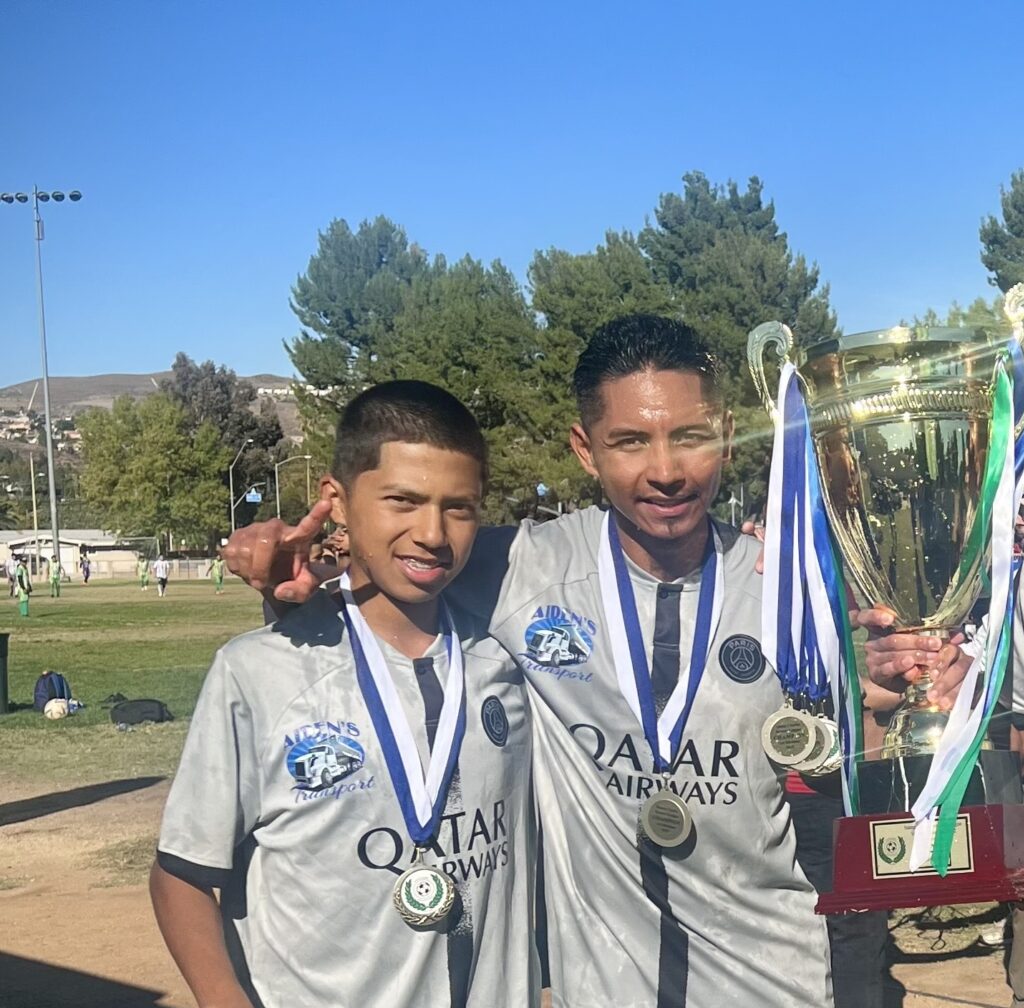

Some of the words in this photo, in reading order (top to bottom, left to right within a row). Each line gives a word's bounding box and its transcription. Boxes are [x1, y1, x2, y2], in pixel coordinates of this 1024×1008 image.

[728, 640, 756, 651] PARIS
[569, 723, 740, 778] QAAR
[606, 772, 738, 805] AIRWAYS
[432, 841, 509, 884] RWAYS
